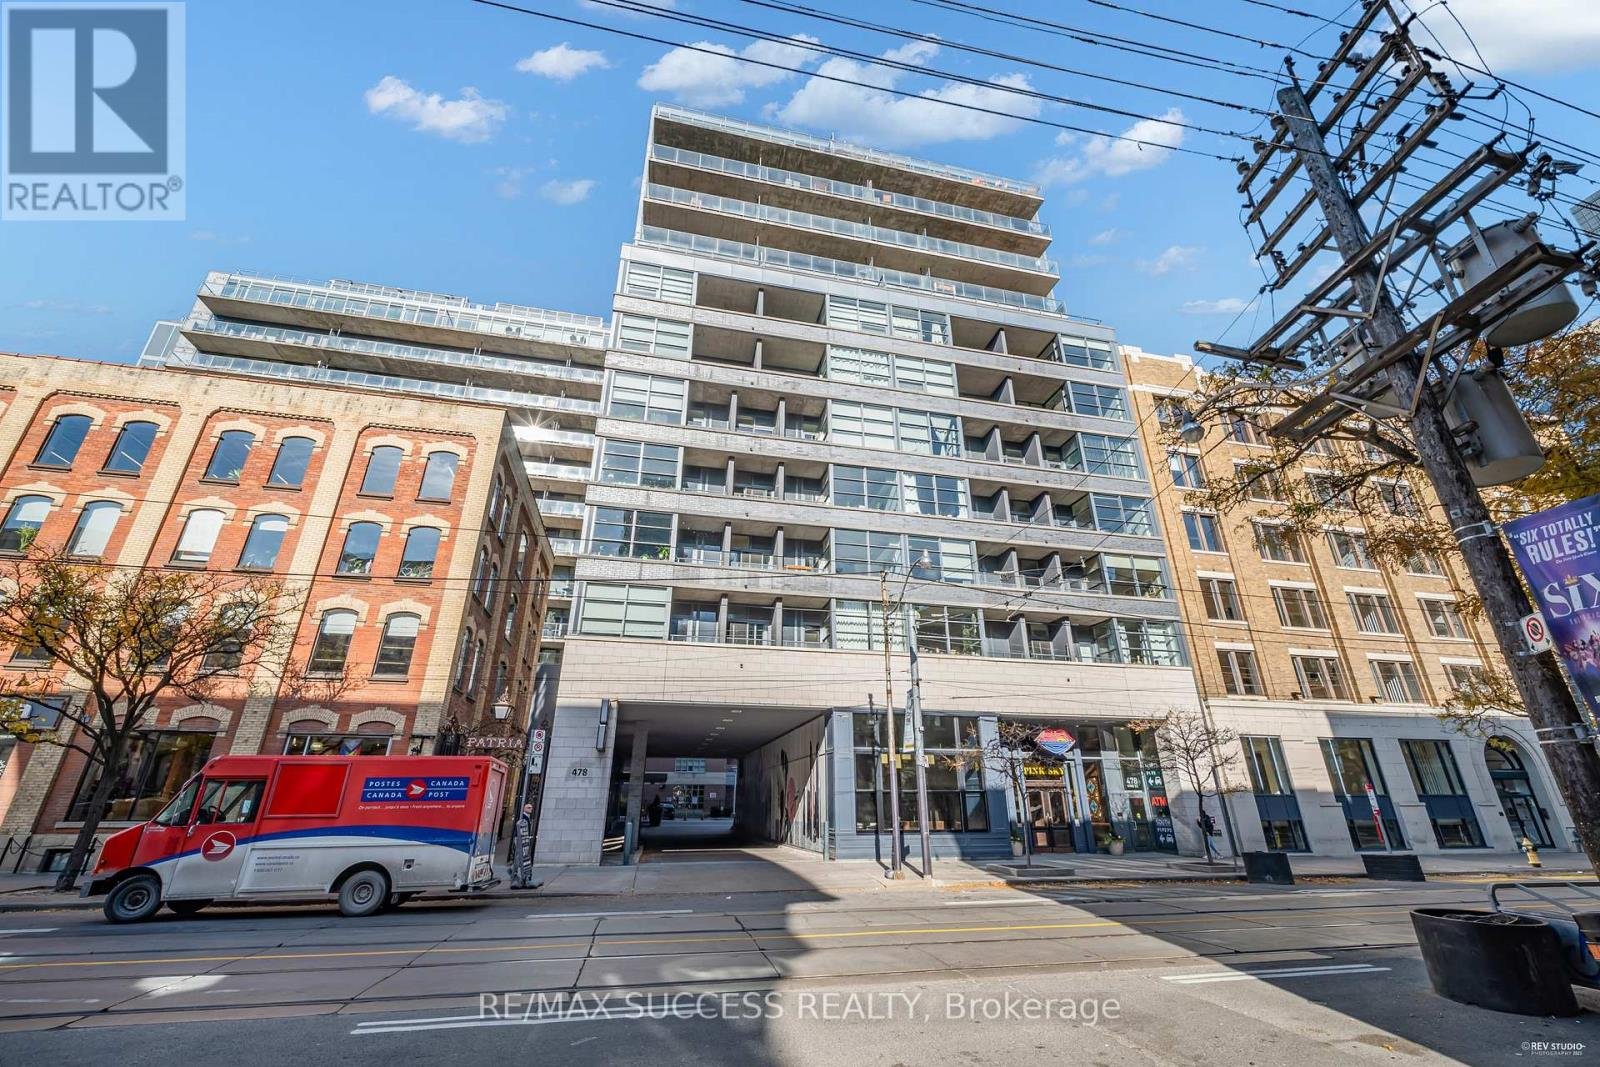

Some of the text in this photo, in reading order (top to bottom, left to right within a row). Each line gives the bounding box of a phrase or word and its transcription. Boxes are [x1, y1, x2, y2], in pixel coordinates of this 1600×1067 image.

[1540, 511, 1593, 538] TOTALLY
[466, 737, 524, 748] PATRIA
[571, 767, 589, 777] 478
[1023, 766, 1064, 776] PINK SKY
[366, 791, 402, 799] CANADA
[1151, 796, 1168, 808] ATM
